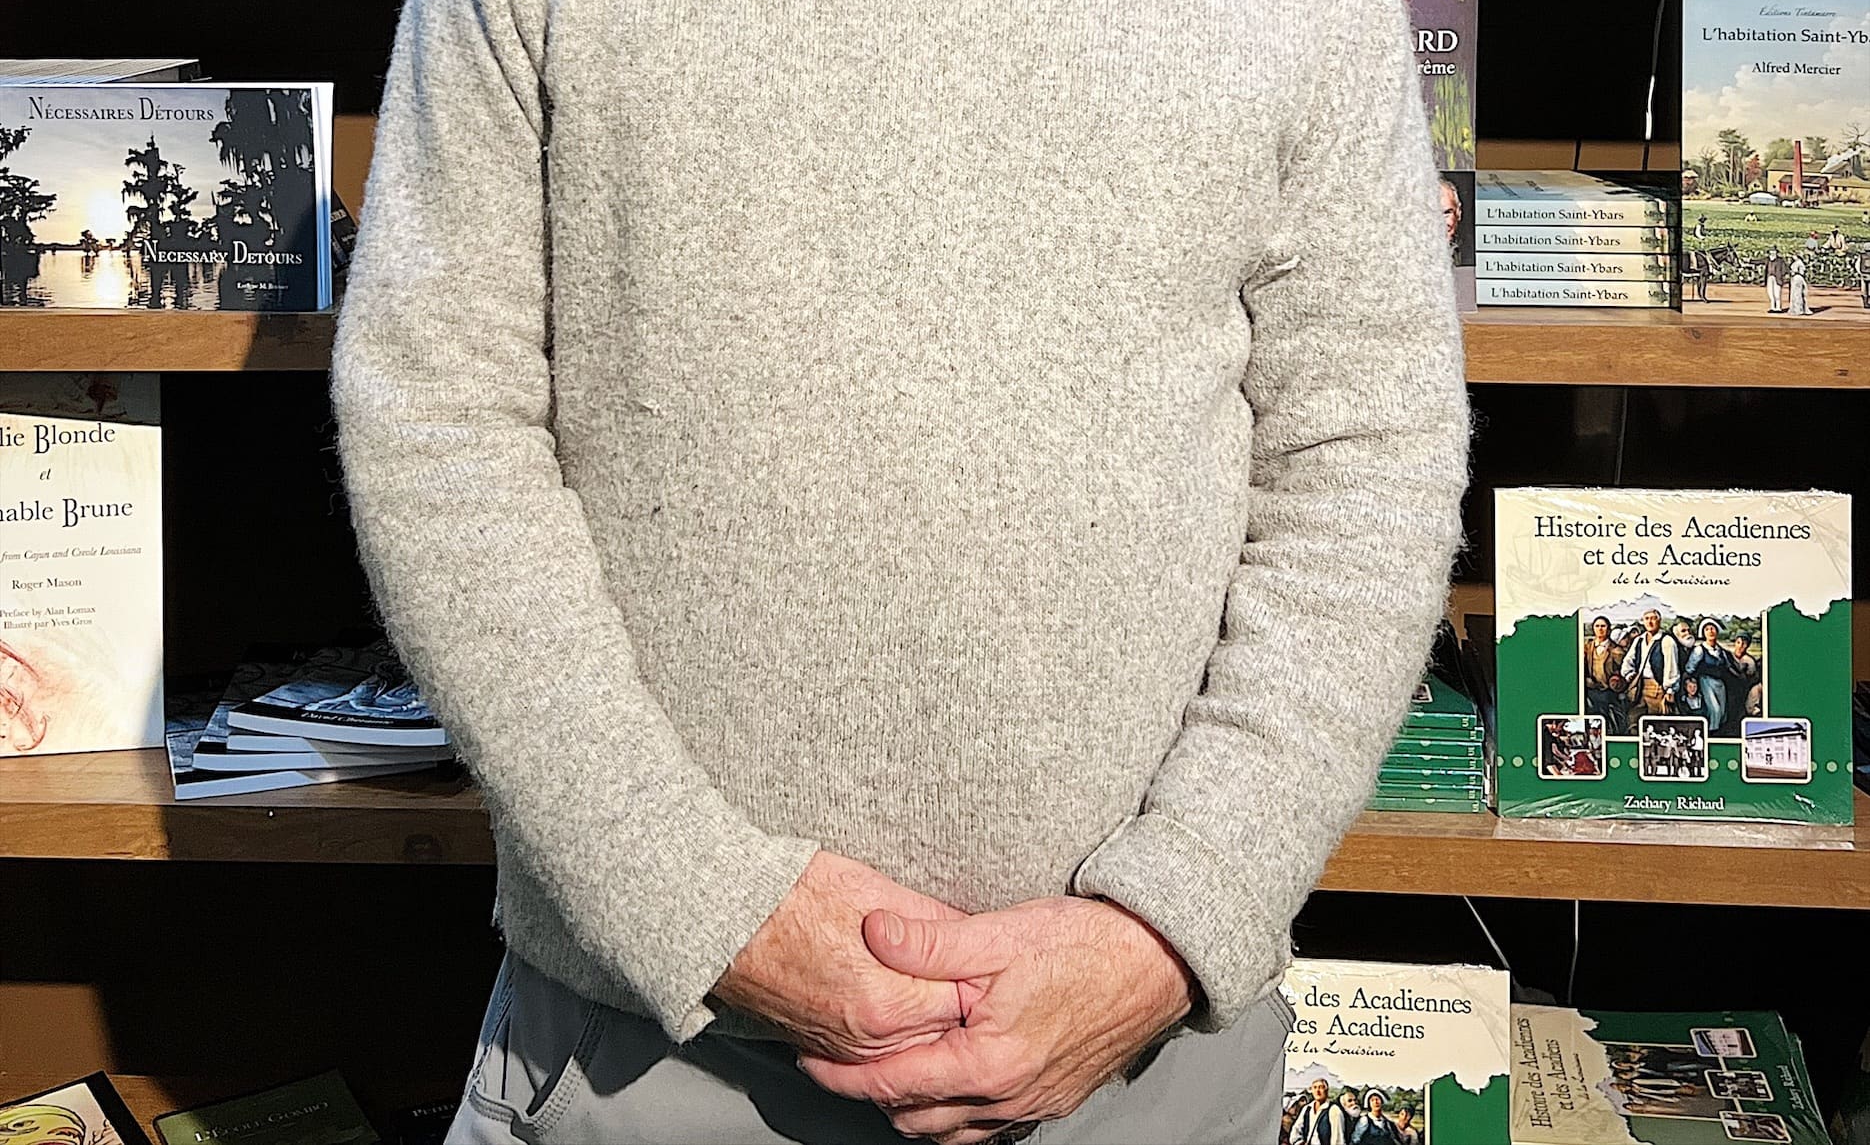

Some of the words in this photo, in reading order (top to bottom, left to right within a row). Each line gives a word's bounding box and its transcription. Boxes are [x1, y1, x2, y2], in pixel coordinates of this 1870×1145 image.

[1702, 27, 1797, 42] L'habitation
[1801, 29, 1870, 44] Saint-Yb
[1417, 59, 1456, 75] rême
[1752, 61, 1791, 74] Alfred
[1793, 62, 1842, 75] Mercier
[1487, 208, 1556, 220] L'habitation
[1558, 209, 1624, 221] Saint-Ybars
[1483, 233, 1552, 246] L'habitation
[1554, 234, 1621, 247] Saint-Ybars
[1485, 260, 1554, 272] L'habitation
[1557, 261, 1624, 274] Saint-Ybars
[1491, 287, 1560, 299] L'habitation
[1562, 288, 1629, 301] Saint-Ybars
[0, 426, 25, 447] lie
[33, 423, 116, 454] Blonde
[39, 468, 51, 481] et
[62, 498, 133, 528] Brune
[1534, 515, 1627, 538] Histoire
[1634, 515, 1673, 538] des
[1681, 515, 1811, 540] Acadiennes
[24, 550, 50, 562] Cajun
[52, 548, 69, 559] and
[100, 545, 142, 556] Louisiana
[1583, 549, 1605, 566] et
[1611, 543, 1649, 566] des
[1657, 543, 1762, 567] Acadiens
[12, 579, 44, 591] Roger
[46, 577, 82, 588] Mason
[1612, 571, 1630, 585] de
[1633, 571, 1651, 585] la
[1655, 569, 1732, 586] Louisiane
[32, 608, 42, 618] by
[45, 607, 65, 616] Alan
[67, 606, 97, 615] Lomax
[34, 621, 49, 630] par
[51, 618, 70, 627] Yves
[1623, 795, 1672, 813] Zachary
[1676, 796, 1725, 811] Richard
[1304, 985, 1341, 1008] des
[1349, 986, 1472, 1014] Acadiennes
[1326, 1013, 1425, 1040] Acadiens
[1303, 1040, 1319, 1055] la
[1323, 1039, 1396, 1057] Louisiane
[1514, 1017, 1540, 1070] Acadiennes
[1541, 1038, 1568, 1081] Acadiens
[1521, 1072, 1543, 1089] des
[1550, 1083, 1571, 1100] des
[1530, 1091, 1553, 1129] Histoire
